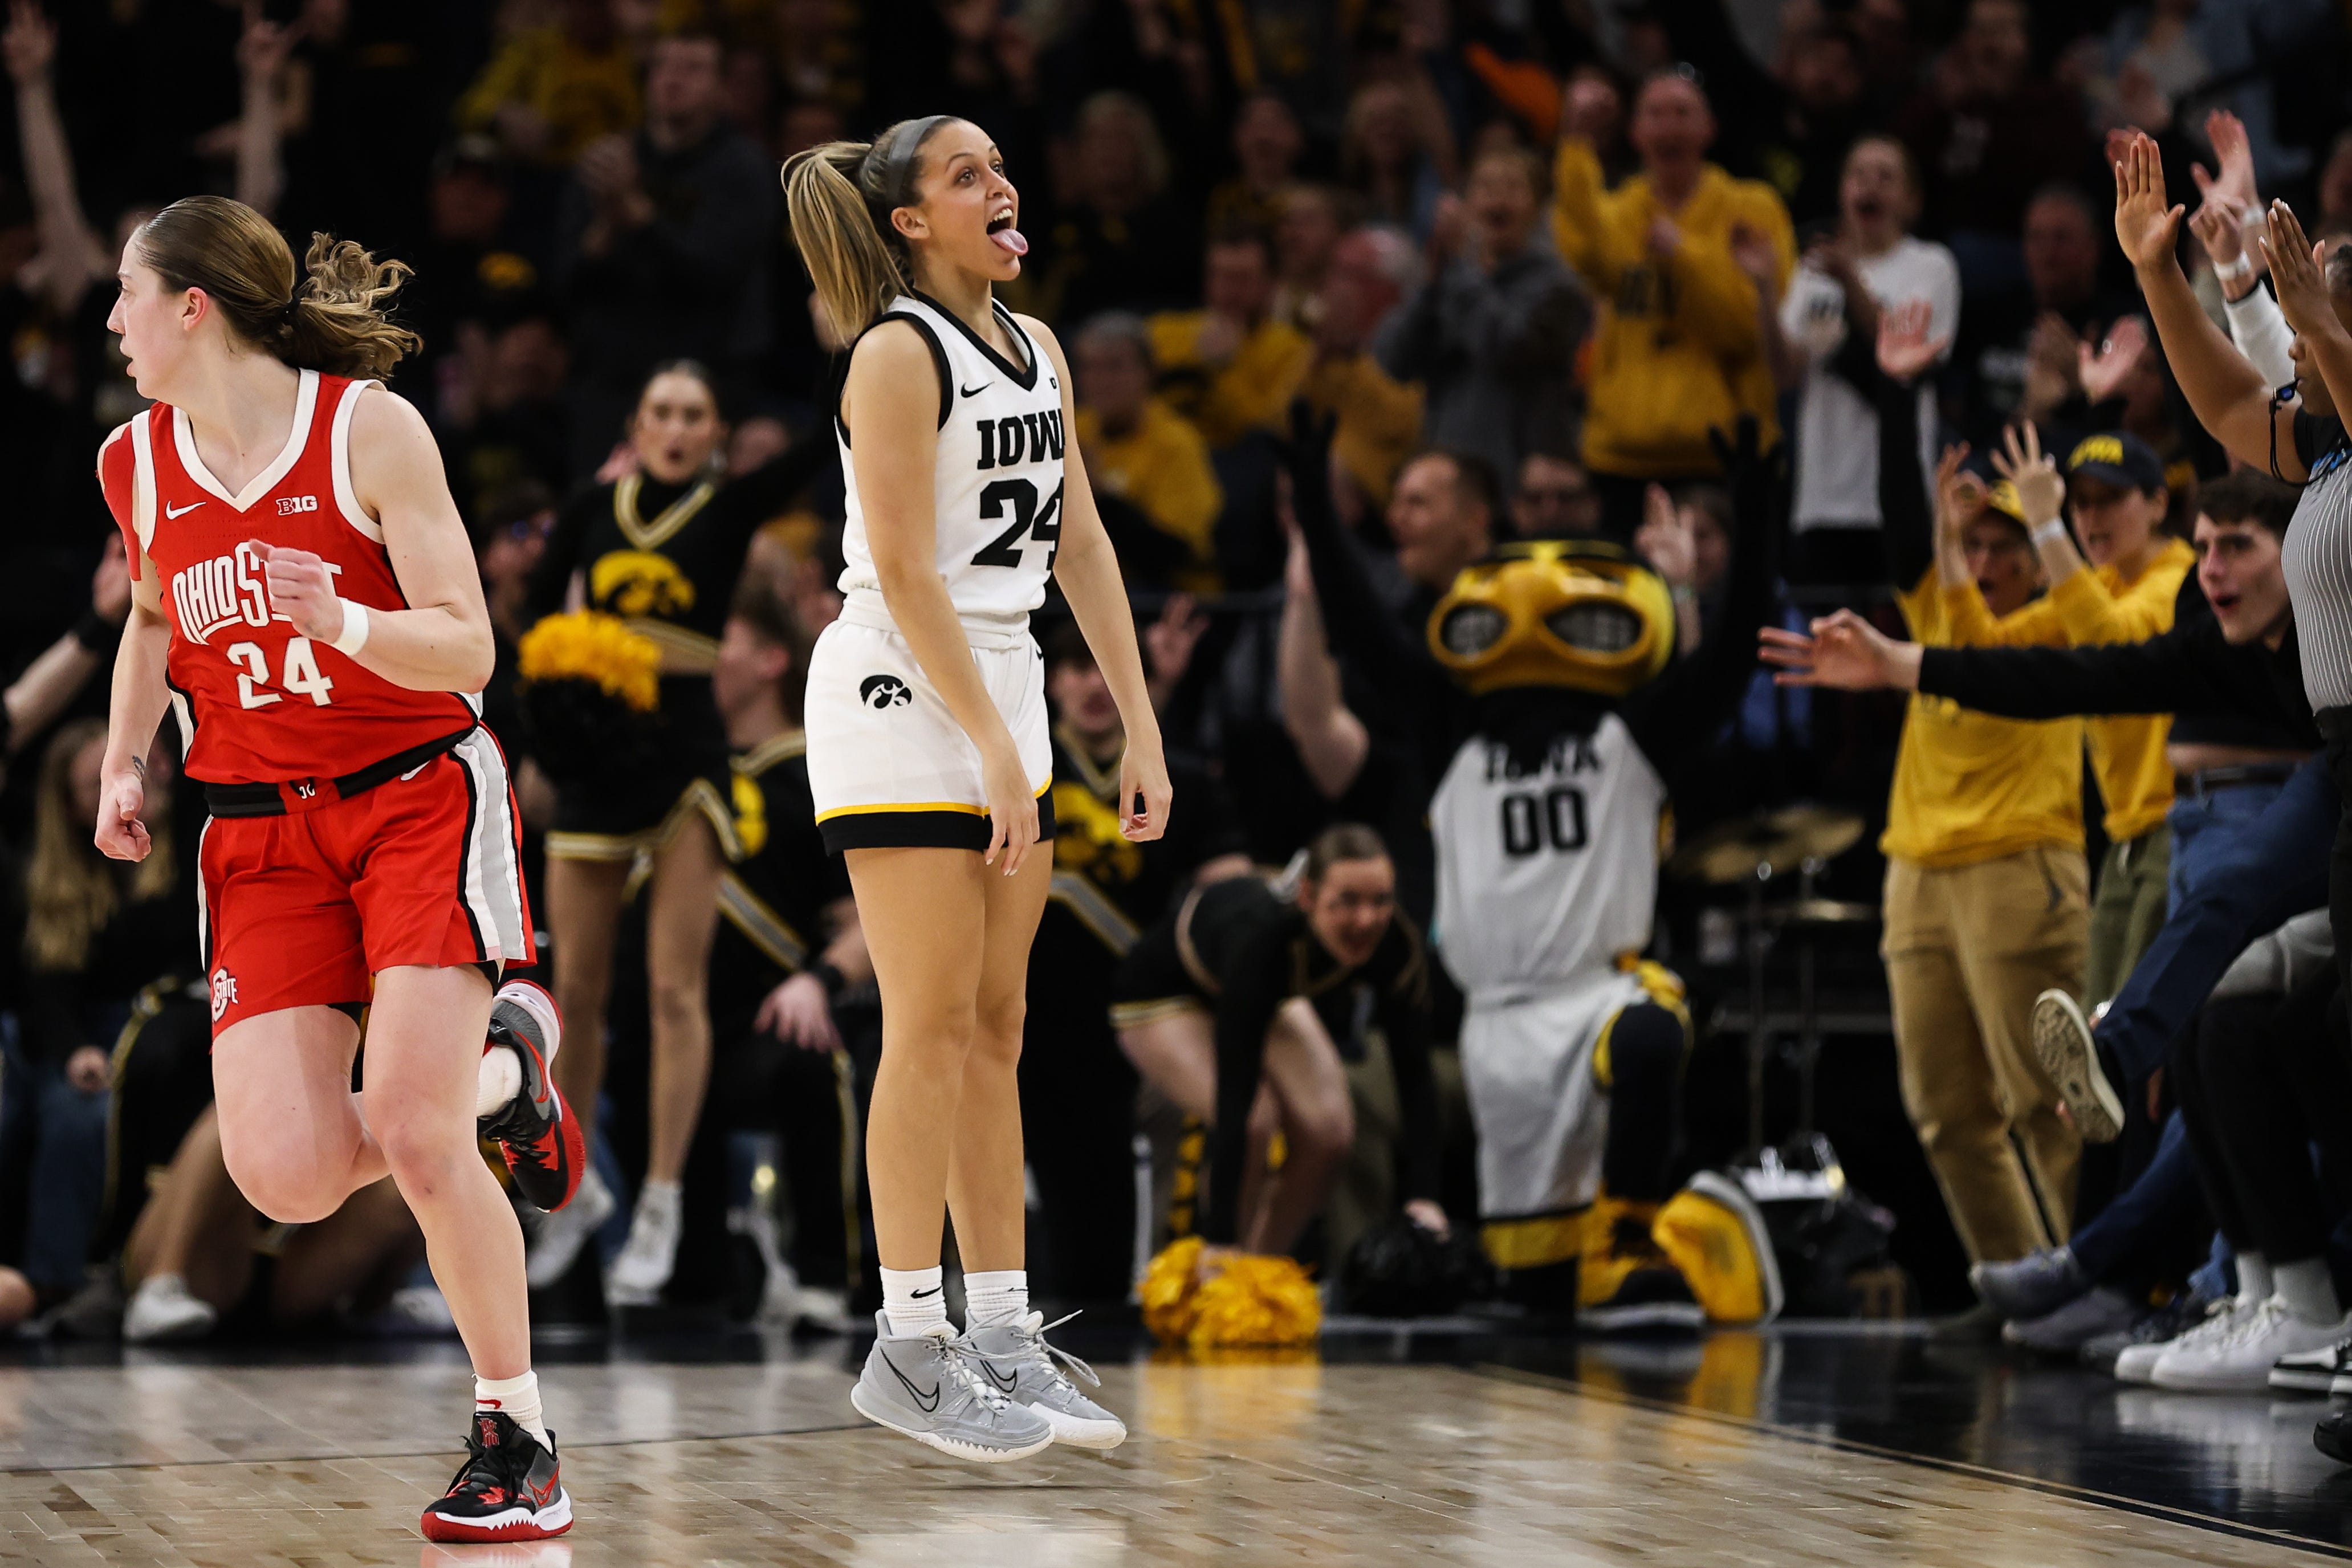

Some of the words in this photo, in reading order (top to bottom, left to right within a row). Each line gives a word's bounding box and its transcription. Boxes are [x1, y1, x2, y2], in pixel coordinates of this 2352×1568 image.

[970, 476, 1064, 571] 24
[226, 637, 334, 709] 24
[1503, 790, 1587, 855] 00
